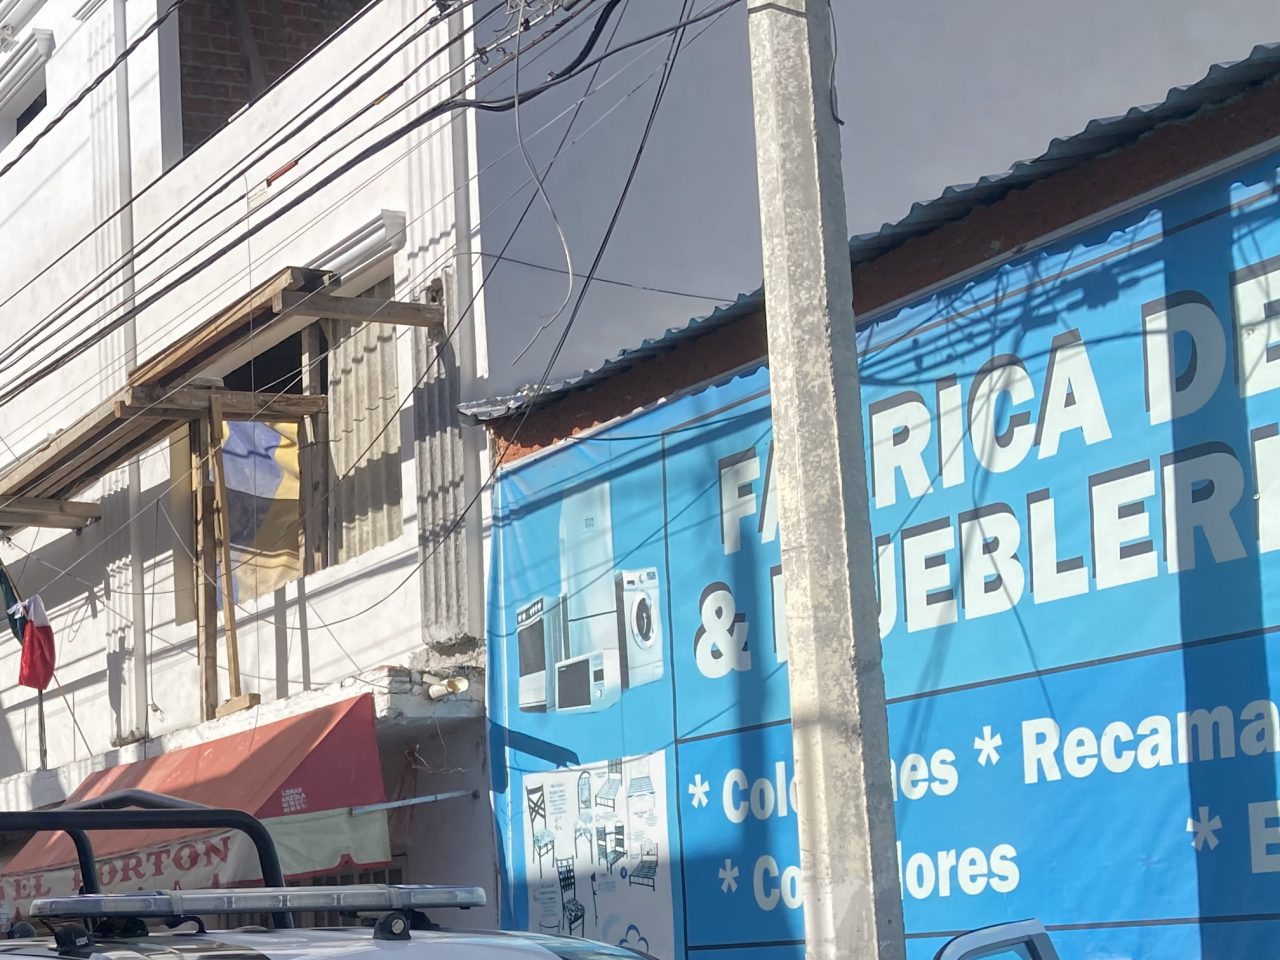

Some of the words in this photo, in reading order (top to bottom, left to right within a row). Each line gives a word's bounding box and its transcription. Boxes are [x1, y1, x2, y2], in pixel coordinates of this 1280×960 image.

[720, 338, 1112, 554] FRICA
[722, 747, 959, 824] Coles
[753, 842, 1020, 911] Coores
